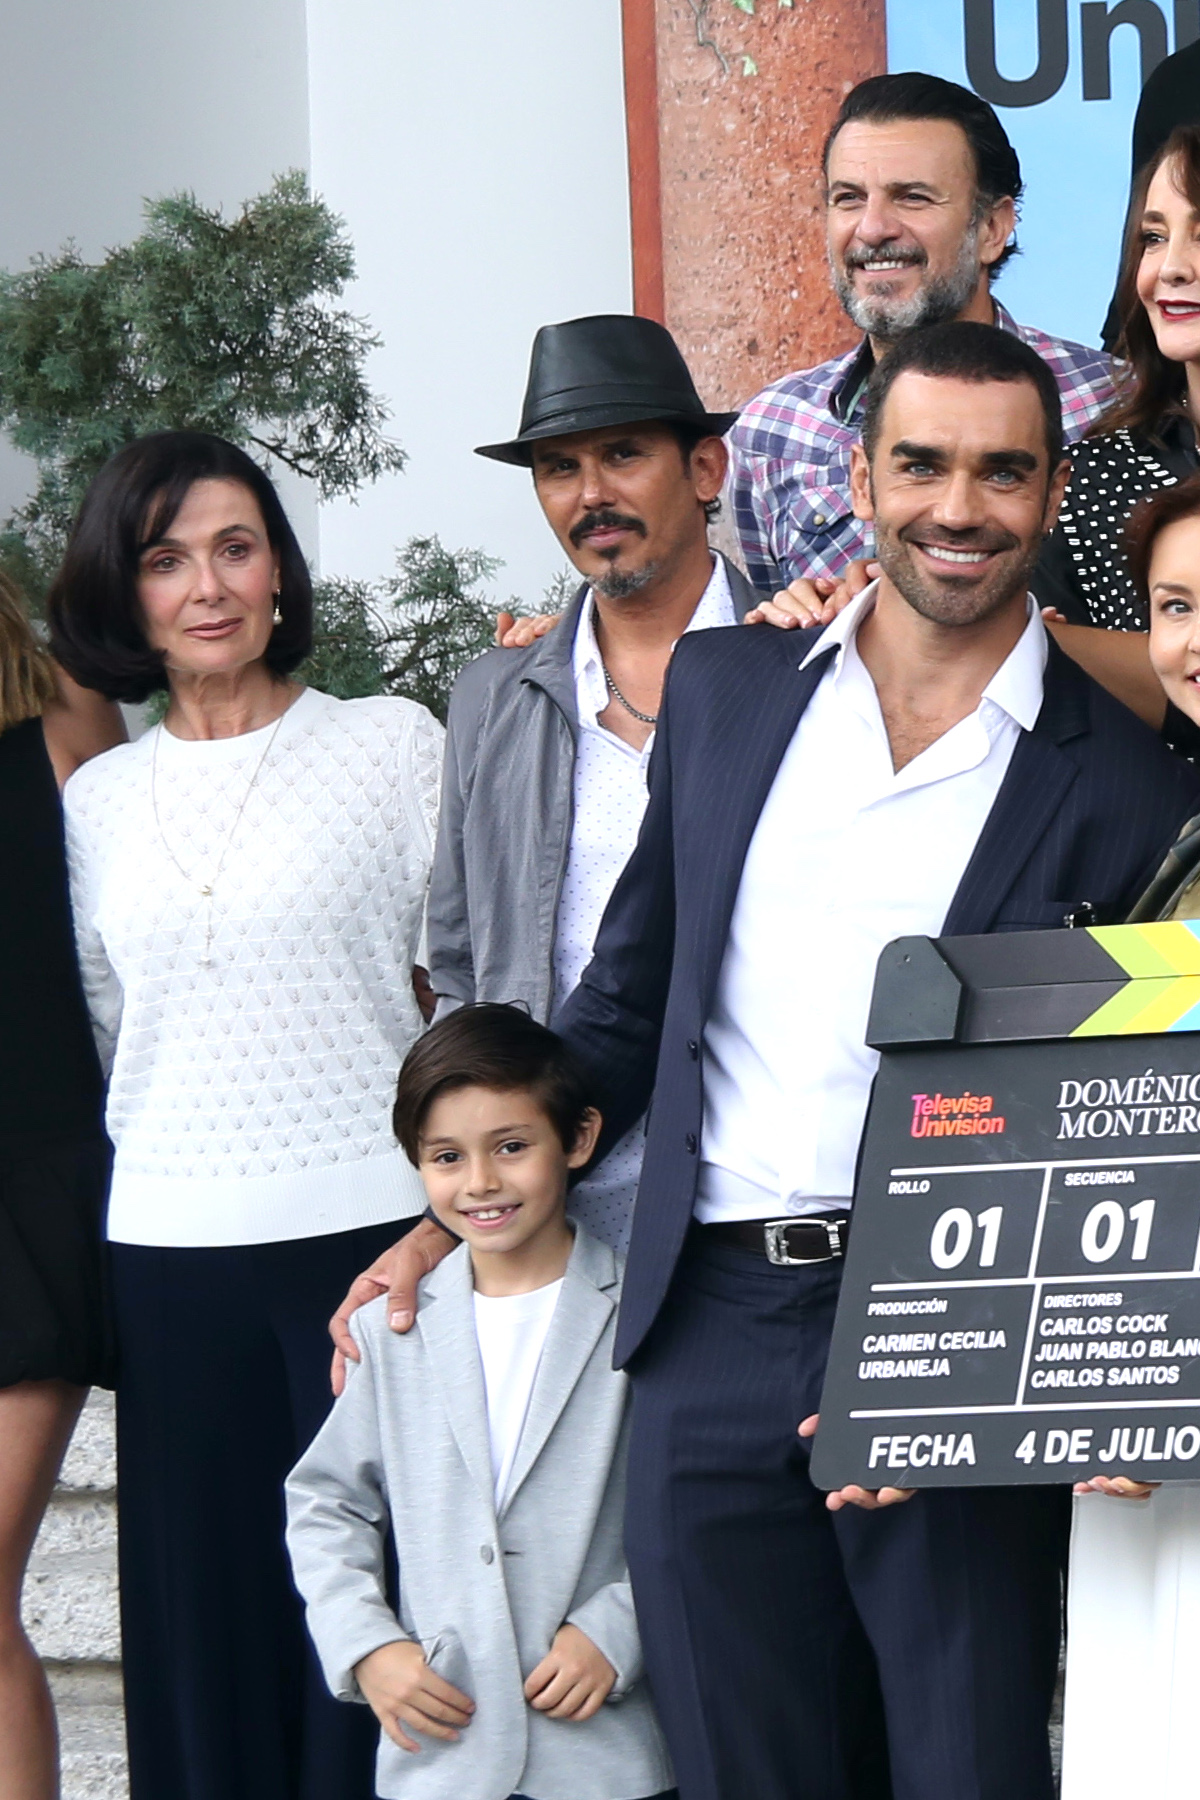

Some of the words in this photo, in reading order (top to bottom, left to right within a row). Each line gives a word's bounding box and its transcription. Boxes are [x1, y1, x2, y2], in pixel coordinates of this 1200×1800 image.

[912, 1092, 993, 1115] Televisa
[911, 1113, 1005, 1138] Univision
[888, 1180, 930, 1194] ROLLO
[1064, 1170, 1135, 1186] SECUENCIA
[930, 1206, 1003, 1269] 01
[1081, 1200, 1155, 1263] 01
[867, 1298, 947, 1315] PRODUCCIÓN
[1043, 1293, 1123, 1309] DIRECTORES
[1040, 1316, 1113, 1336] CARLOS
[1115, 1314, 1168, 1333] COCK
[863, 1333, 936, 1353] CARMEN
[939, 1330, 1006, 1350] CECILIA
[1035, 1342, 1084, 1362] JUAN
[1086, 1340, 1146, 1359] PABLO
[858, 1358, 950, 1379] URBANEJA
[1031, 1368, 1104, 1388] CARLOS
[1107, 1366, 1180, 1386] SANTOS
[868, 1434, 976, 1468] FECHA
[1015, 1431, 1036, 1464] 4
[1043, 1429, 1093, 1463] DE
[1098, 1426, 1200, 1462] JULIO
